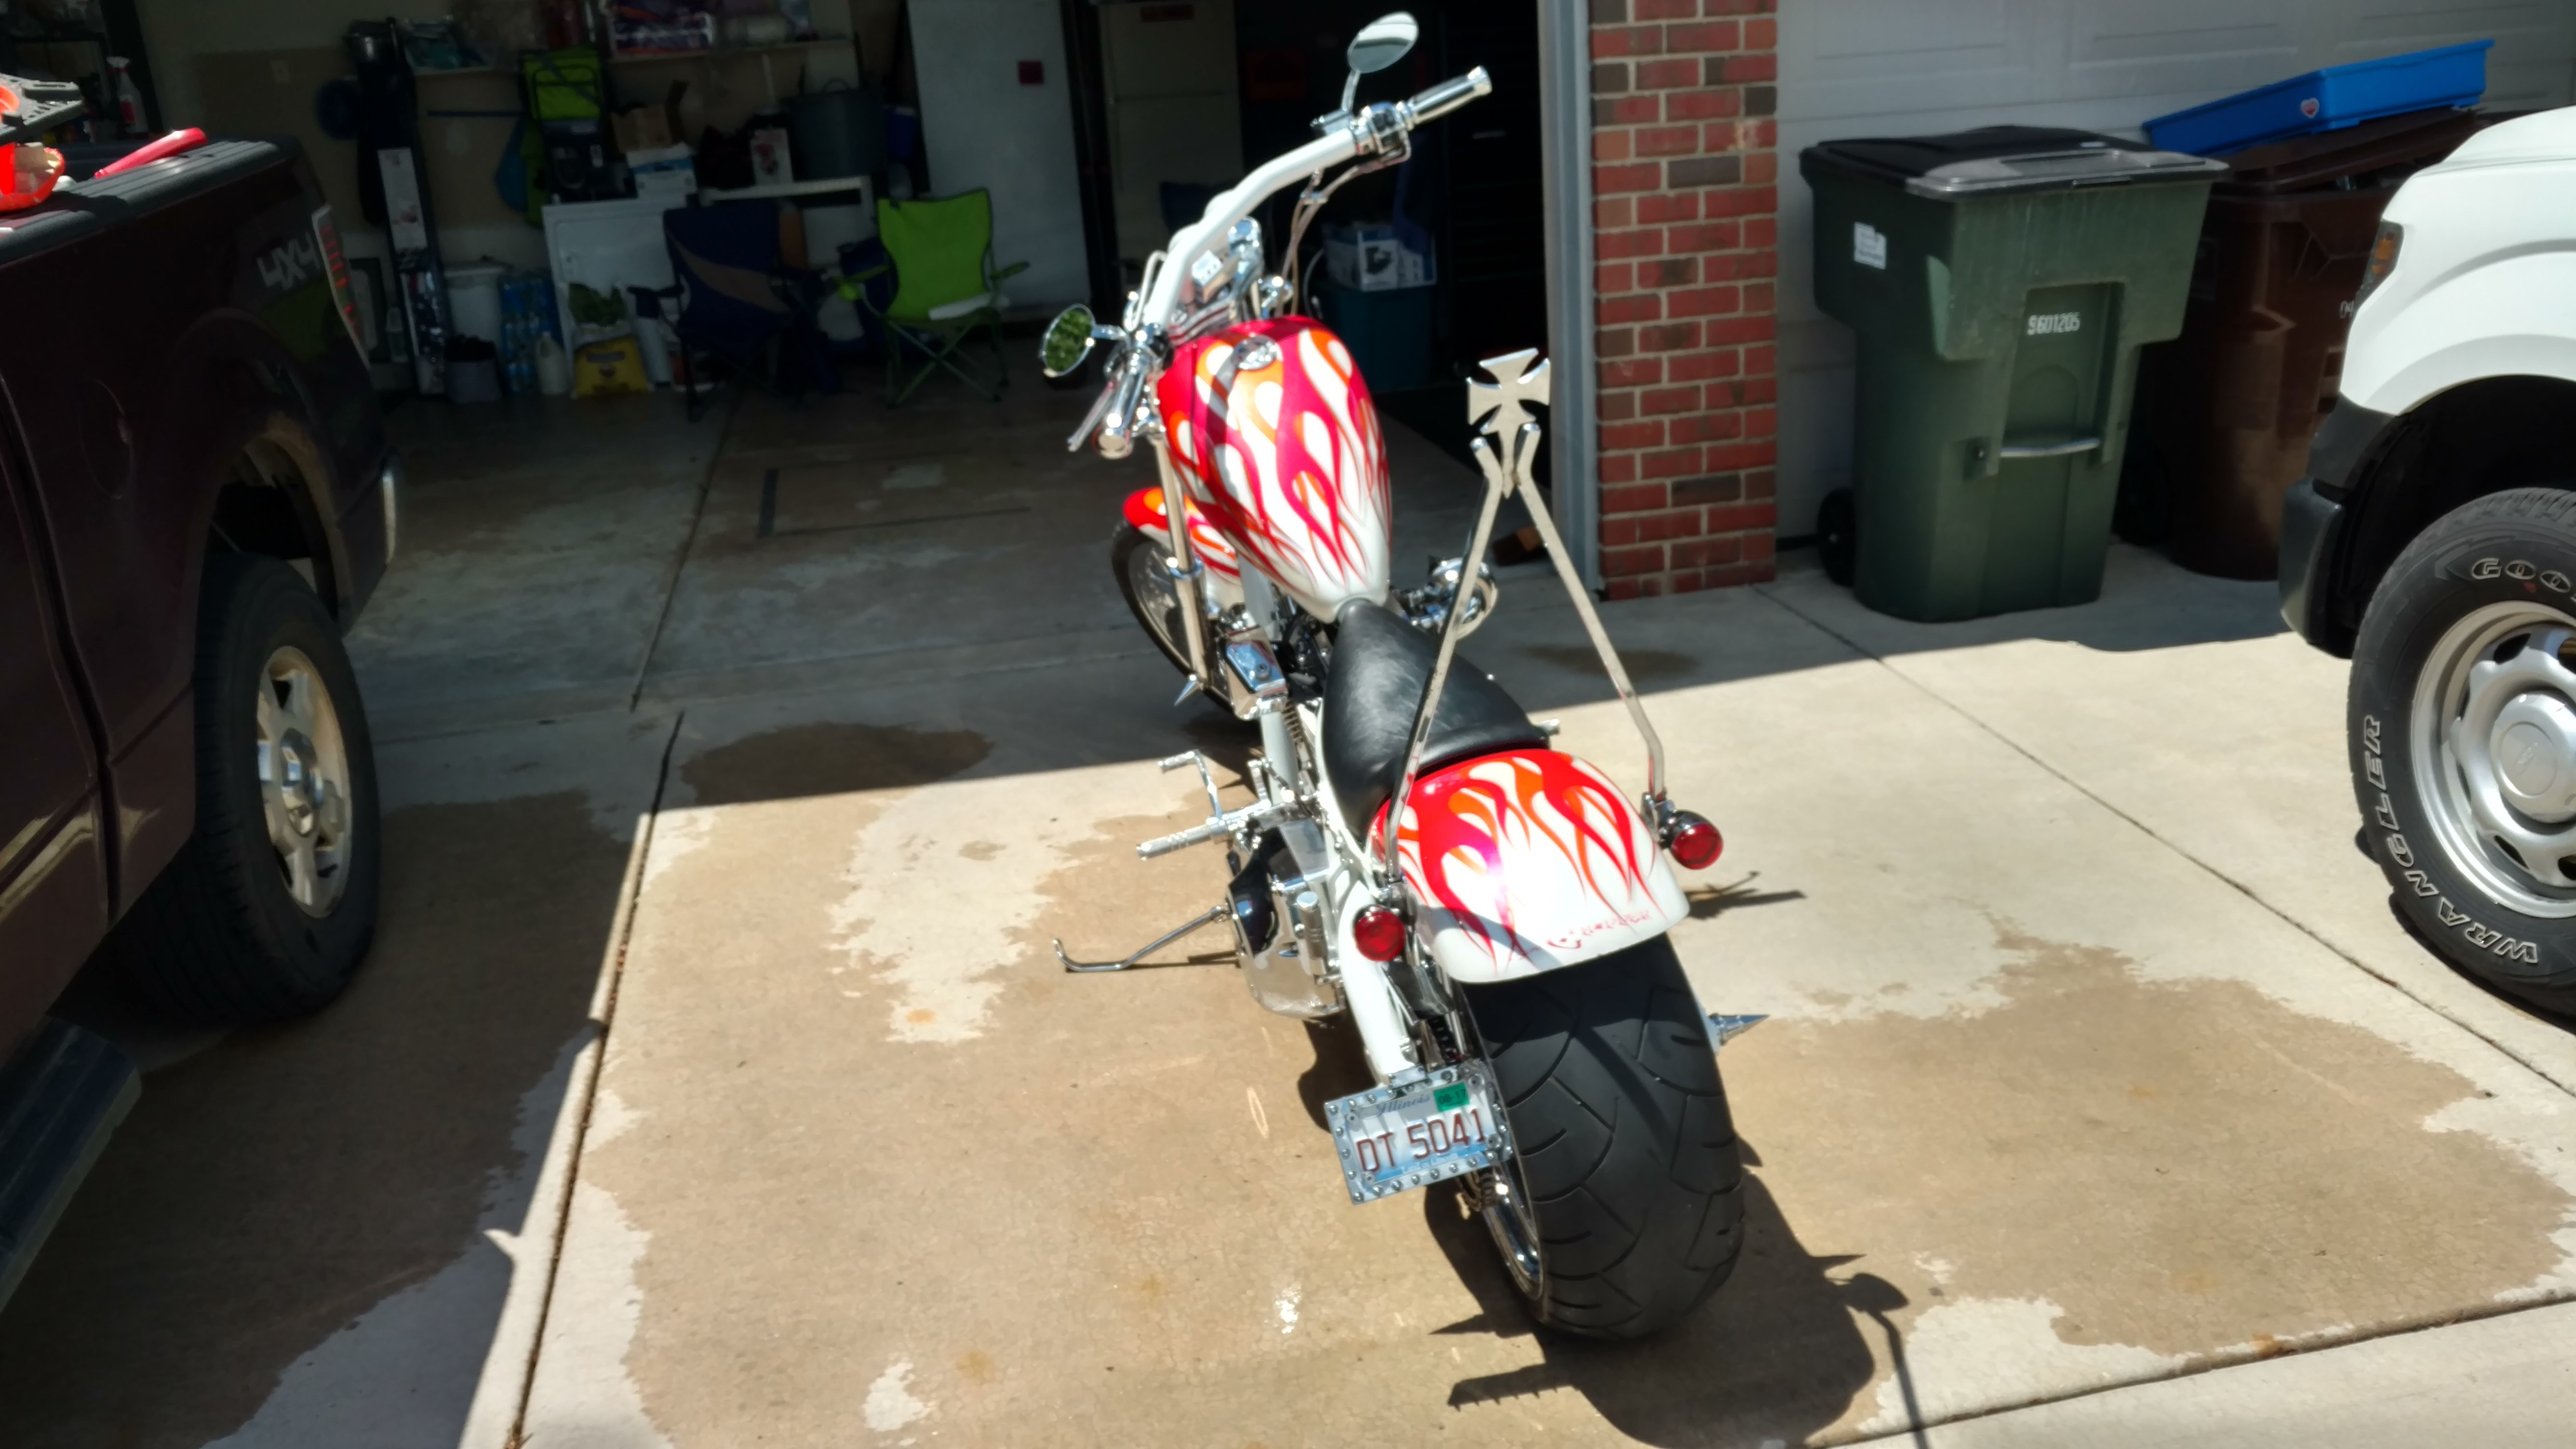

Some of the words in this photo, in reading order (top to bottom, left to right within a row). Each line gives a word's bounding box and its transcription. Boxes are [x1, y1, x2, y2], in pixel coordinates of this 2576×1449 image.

[2471, 557, 2576, 603] GOO
[2364, 714, 2539, 964] WRANGLER
[1356, 1131, 1396, 1172] DT
[1406, 1108, 1485, 1160] 5041
